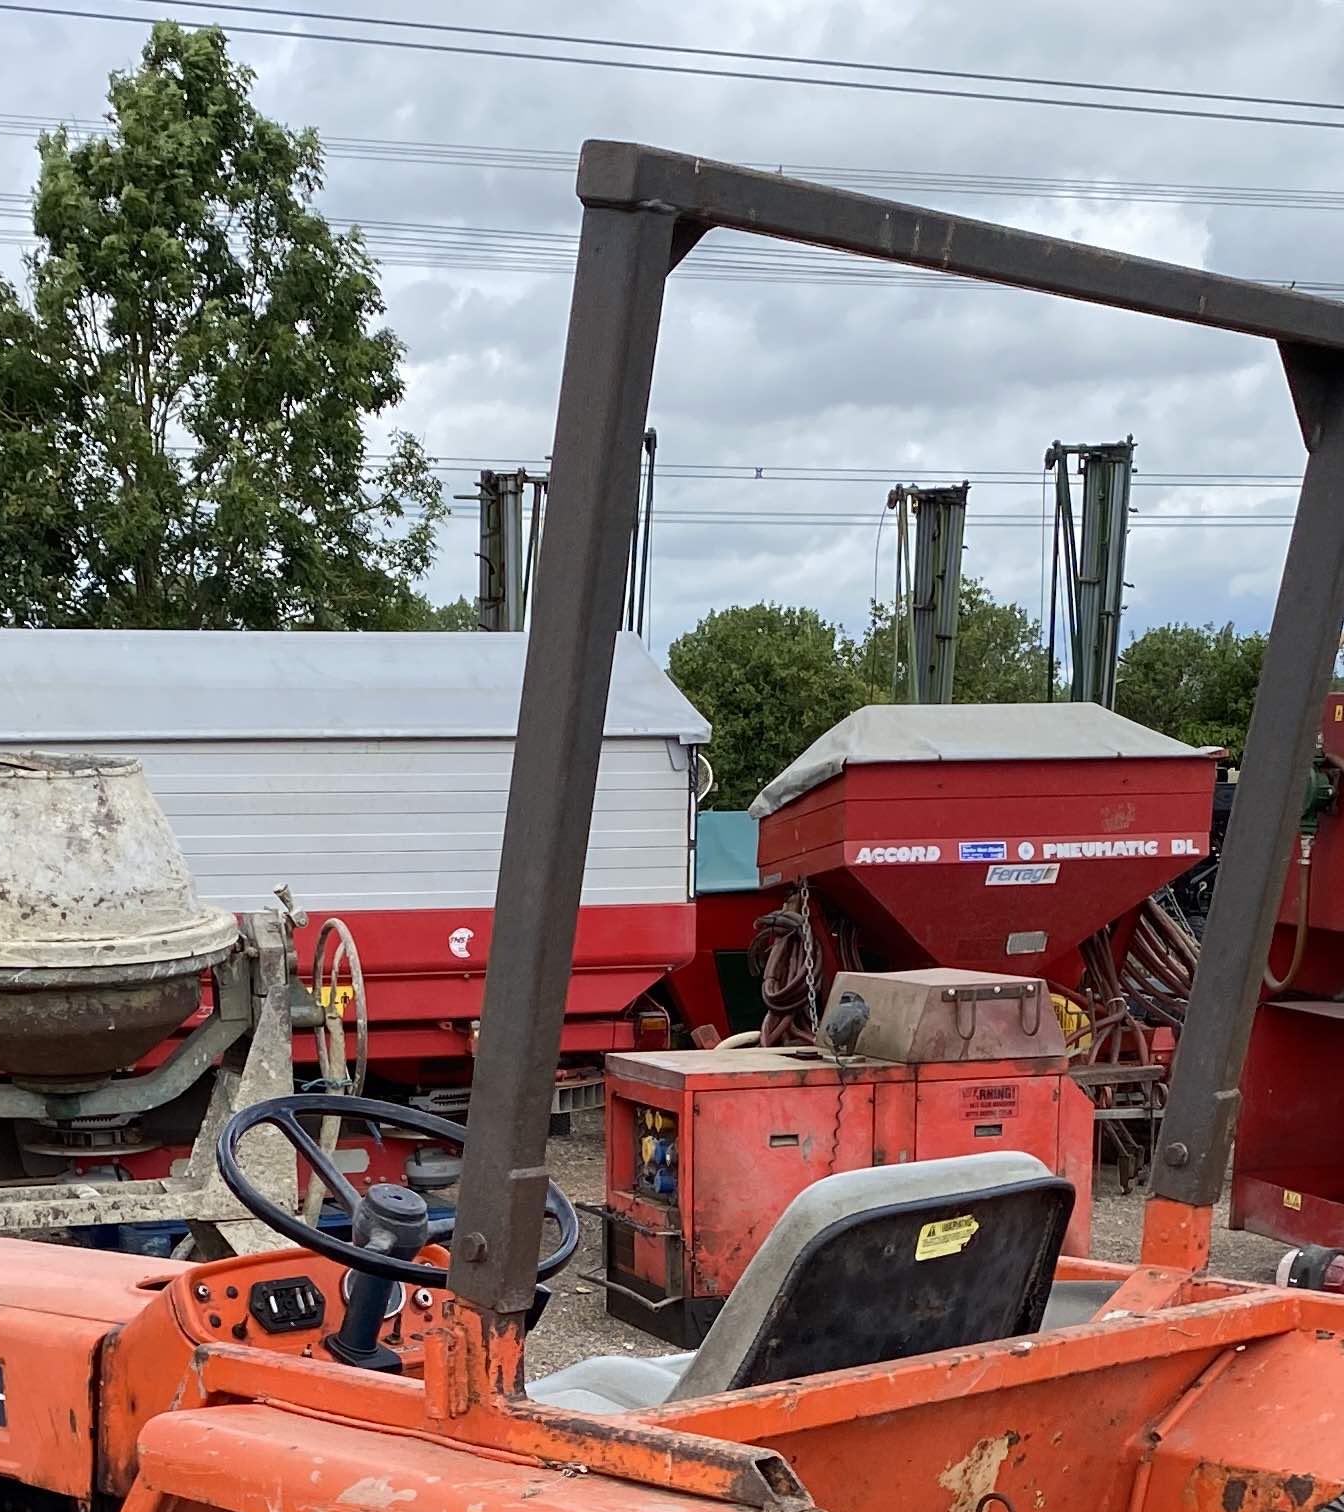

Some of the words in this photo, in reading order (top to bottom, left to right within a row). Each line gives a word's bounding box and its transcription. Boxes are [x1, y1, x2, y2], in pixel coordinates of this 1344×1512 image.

[854, 846, 941, 863] ACCORD
[1043, 840, 1158, 859] PNEUMATIC
[1170, 839, 1200, 855] DL
